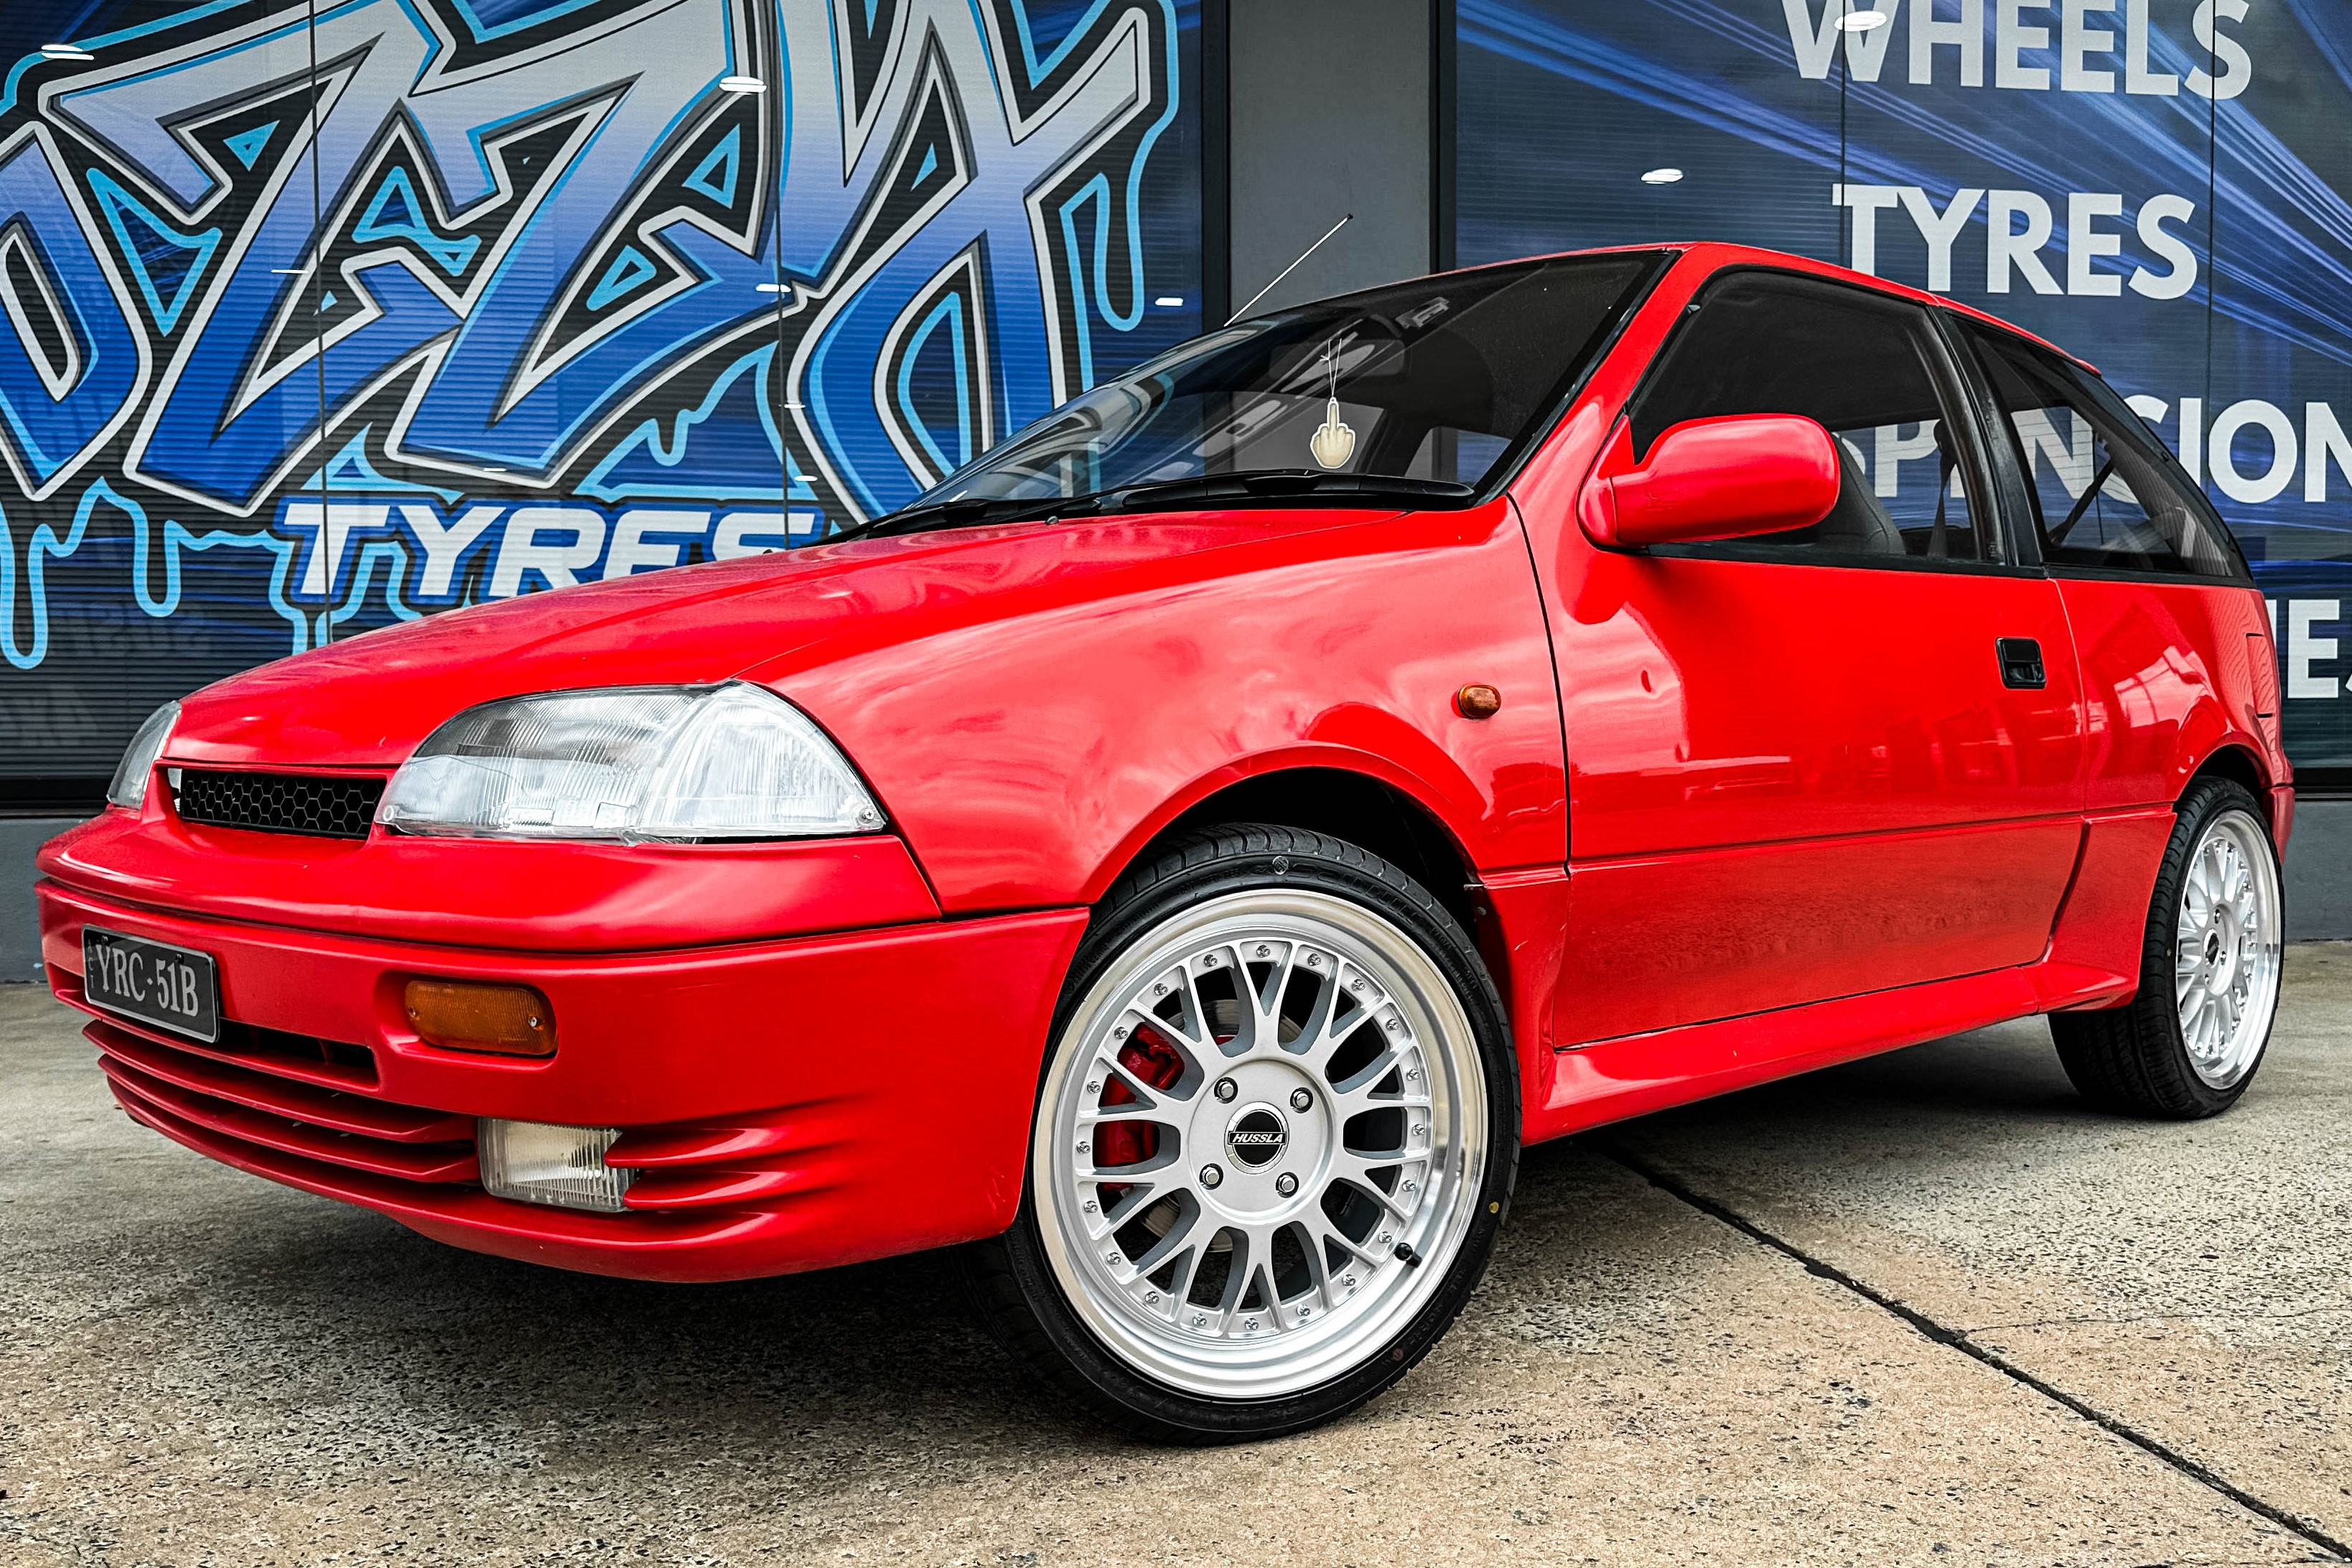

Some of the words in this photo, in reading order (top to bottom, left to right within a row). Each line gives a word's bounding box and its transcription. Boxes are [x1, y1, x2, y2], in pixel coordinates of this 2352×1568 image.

[1781, 0, 2253, 101] WHEELS
[1831, 182, 2198, 300] TYRES
[1232, 1133, 1284, 1143] HUSSLA
